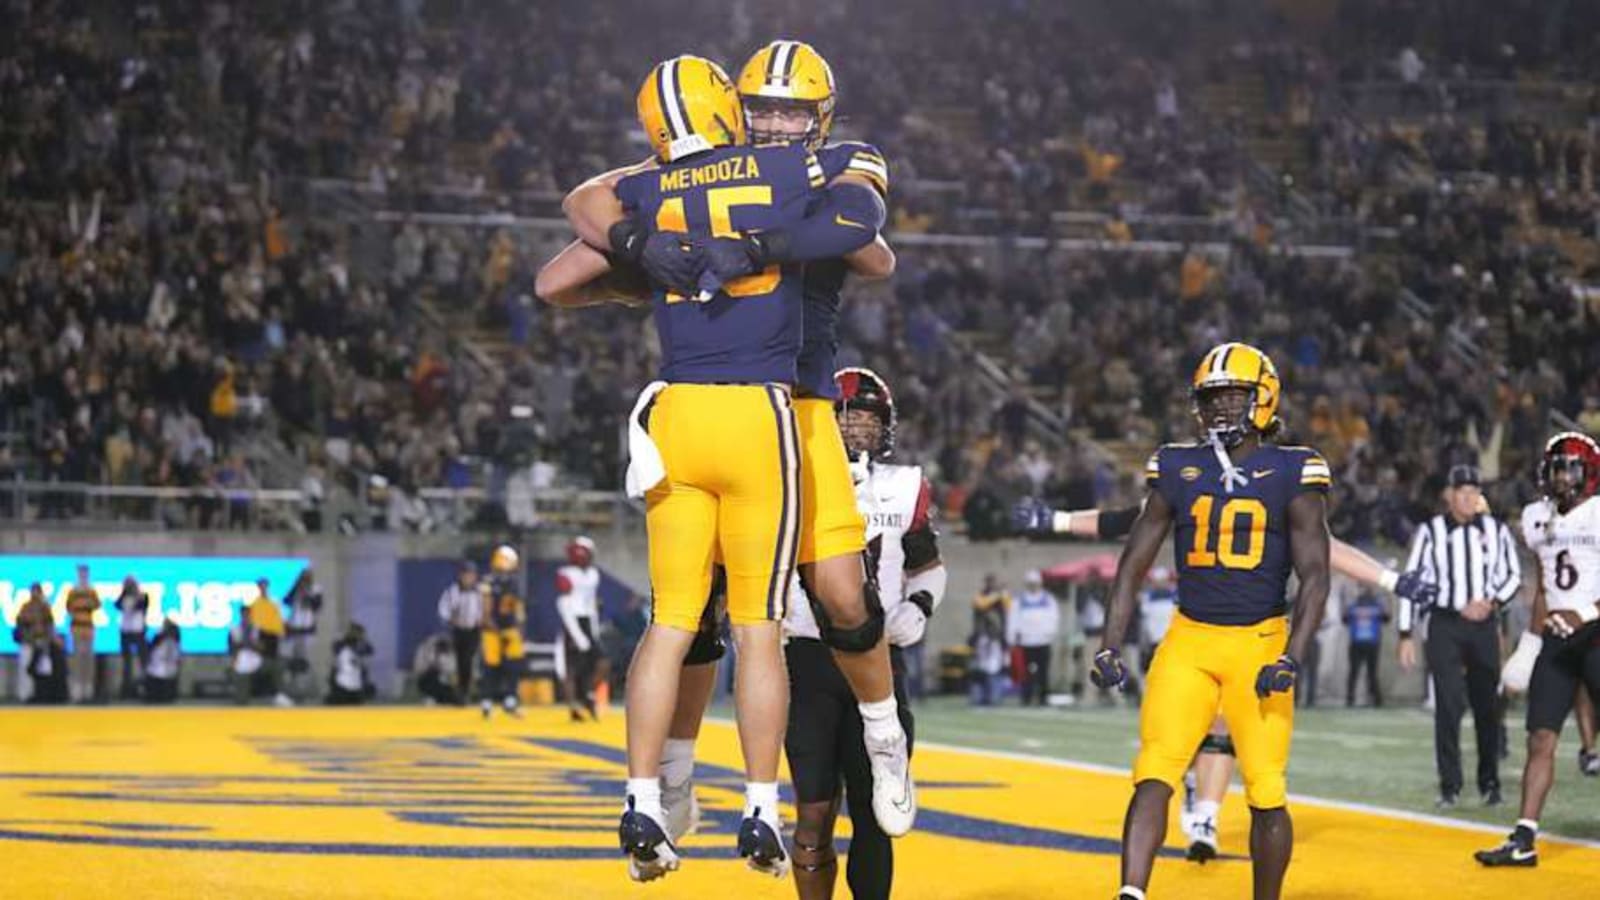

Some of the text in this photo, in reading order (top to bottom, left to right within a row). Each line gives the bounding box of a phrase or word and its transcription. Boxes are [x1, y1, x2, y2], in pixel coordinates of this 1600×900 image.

[660, 155, 760, 192] MENDOZA
[656, 185, 782, 305] 15
[1187, 494, 1267, 570] 10
[1555, 549, 1579, 591] 6
